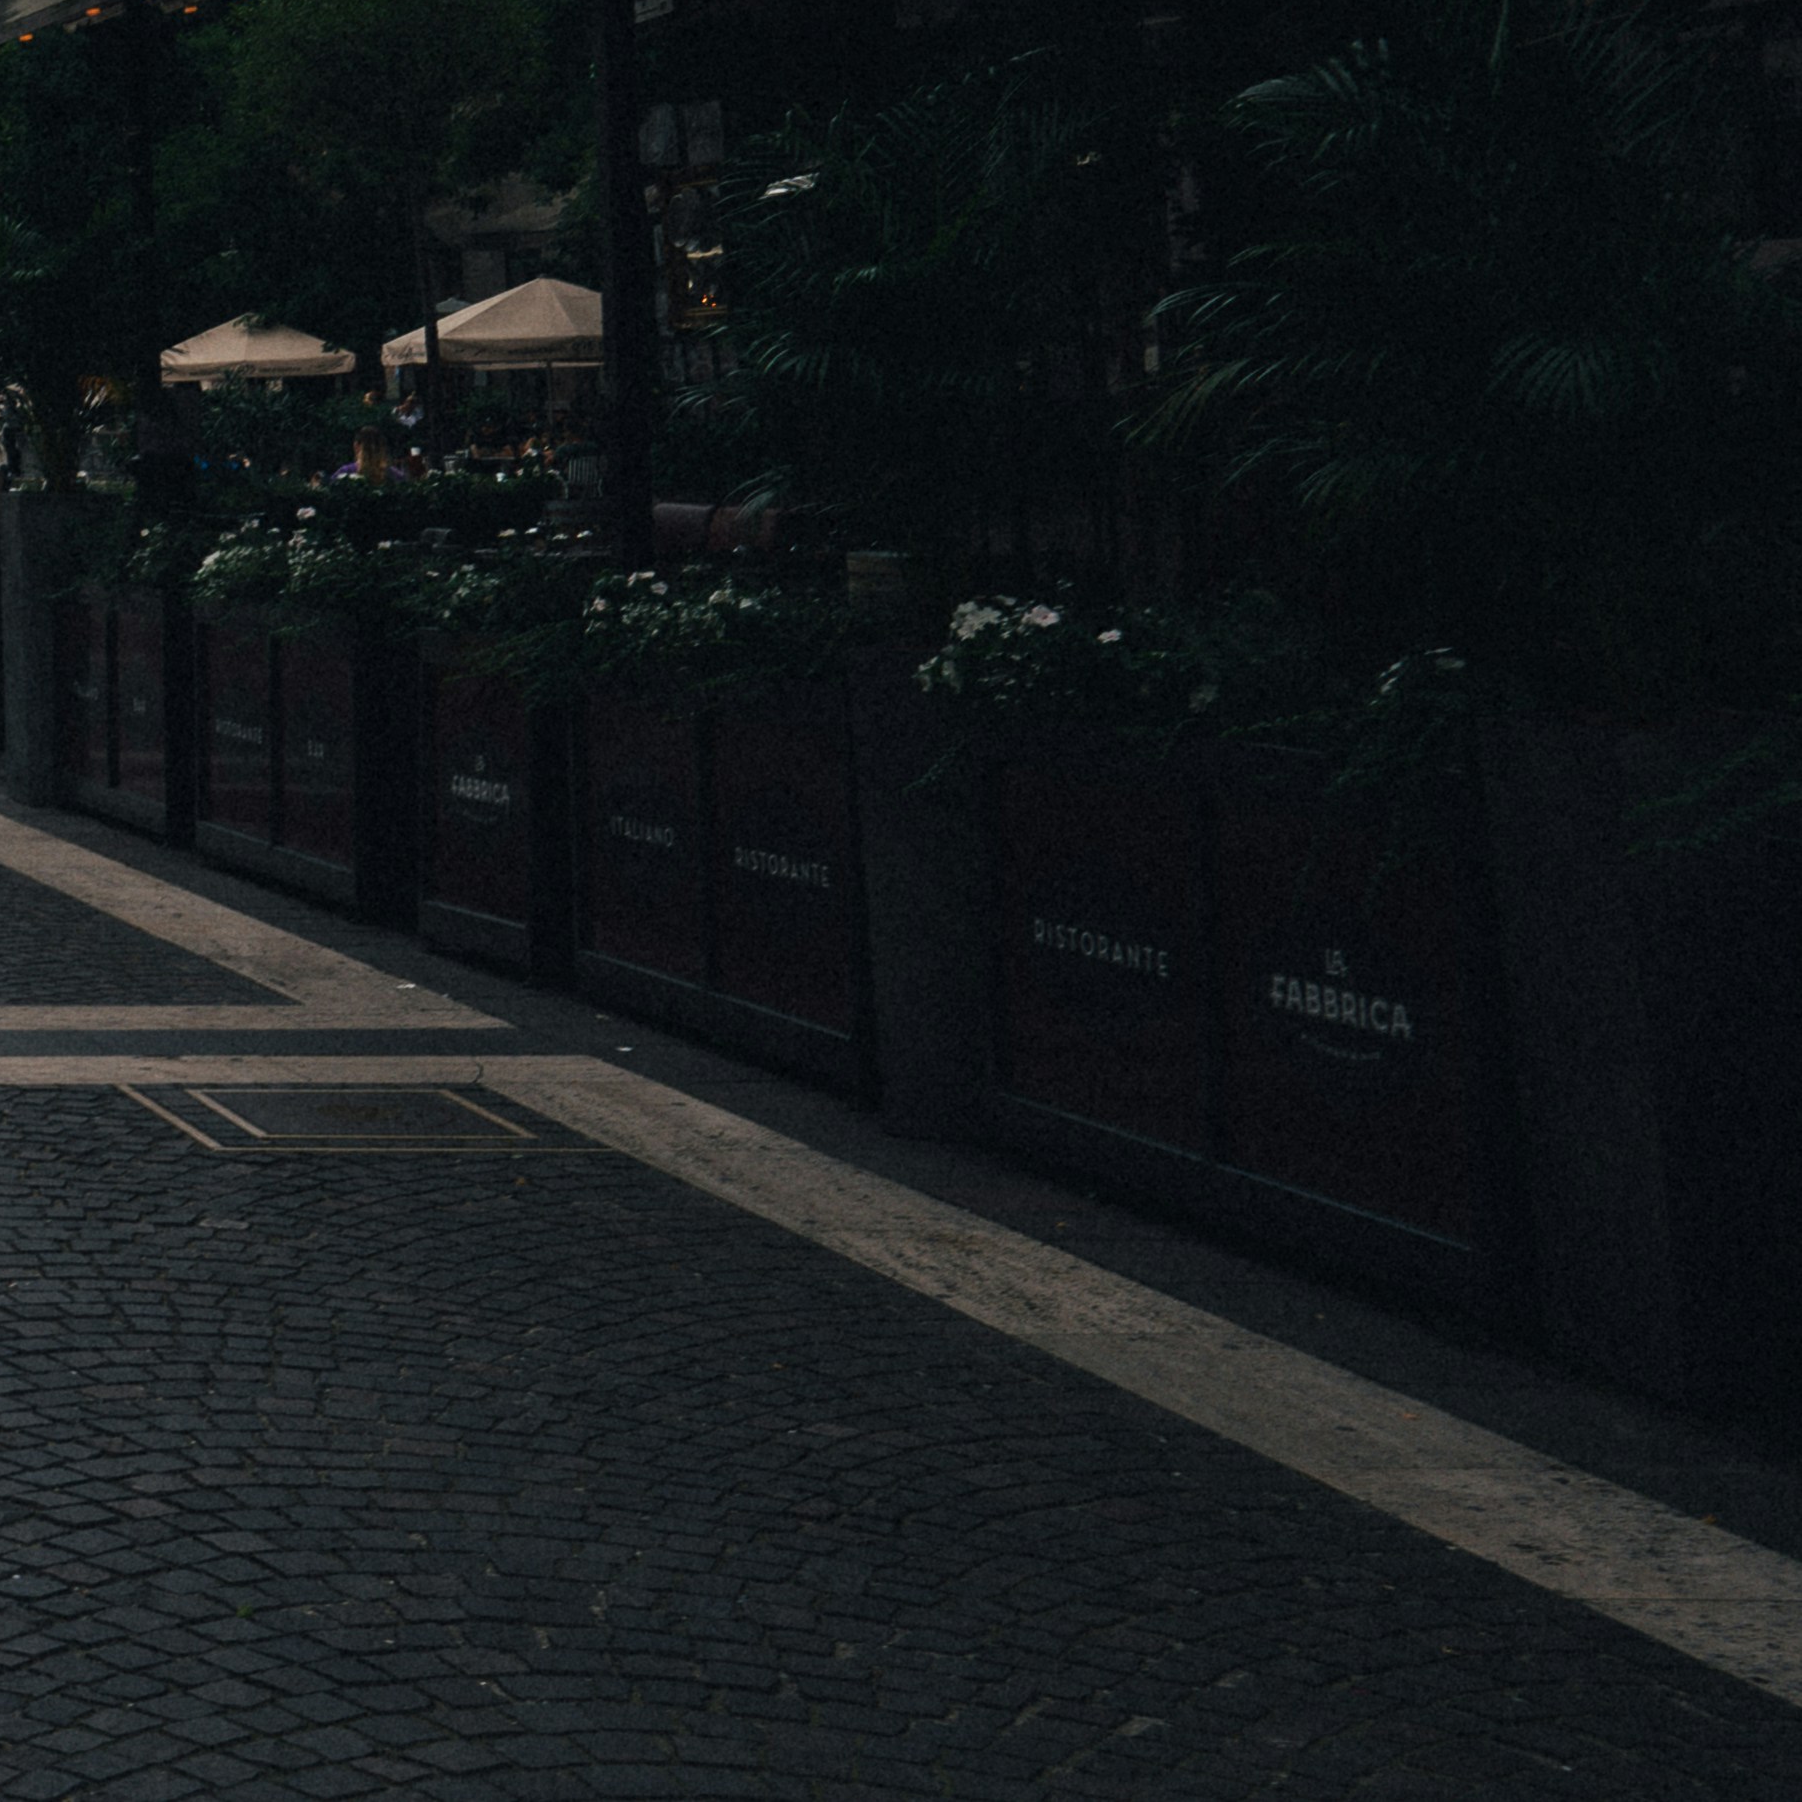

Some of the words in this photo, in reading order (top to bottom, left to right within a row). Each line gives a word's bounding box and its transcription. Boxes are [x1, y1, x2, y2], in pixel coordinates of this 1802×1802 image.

[610, 814, 675, 848] ITALIANO
[734, 845, 832, 888] RISTORANTE
[1032, 918, 1169, 979] RISTORANTE
[1269, 975, 1415, 1040] FABBRICA
